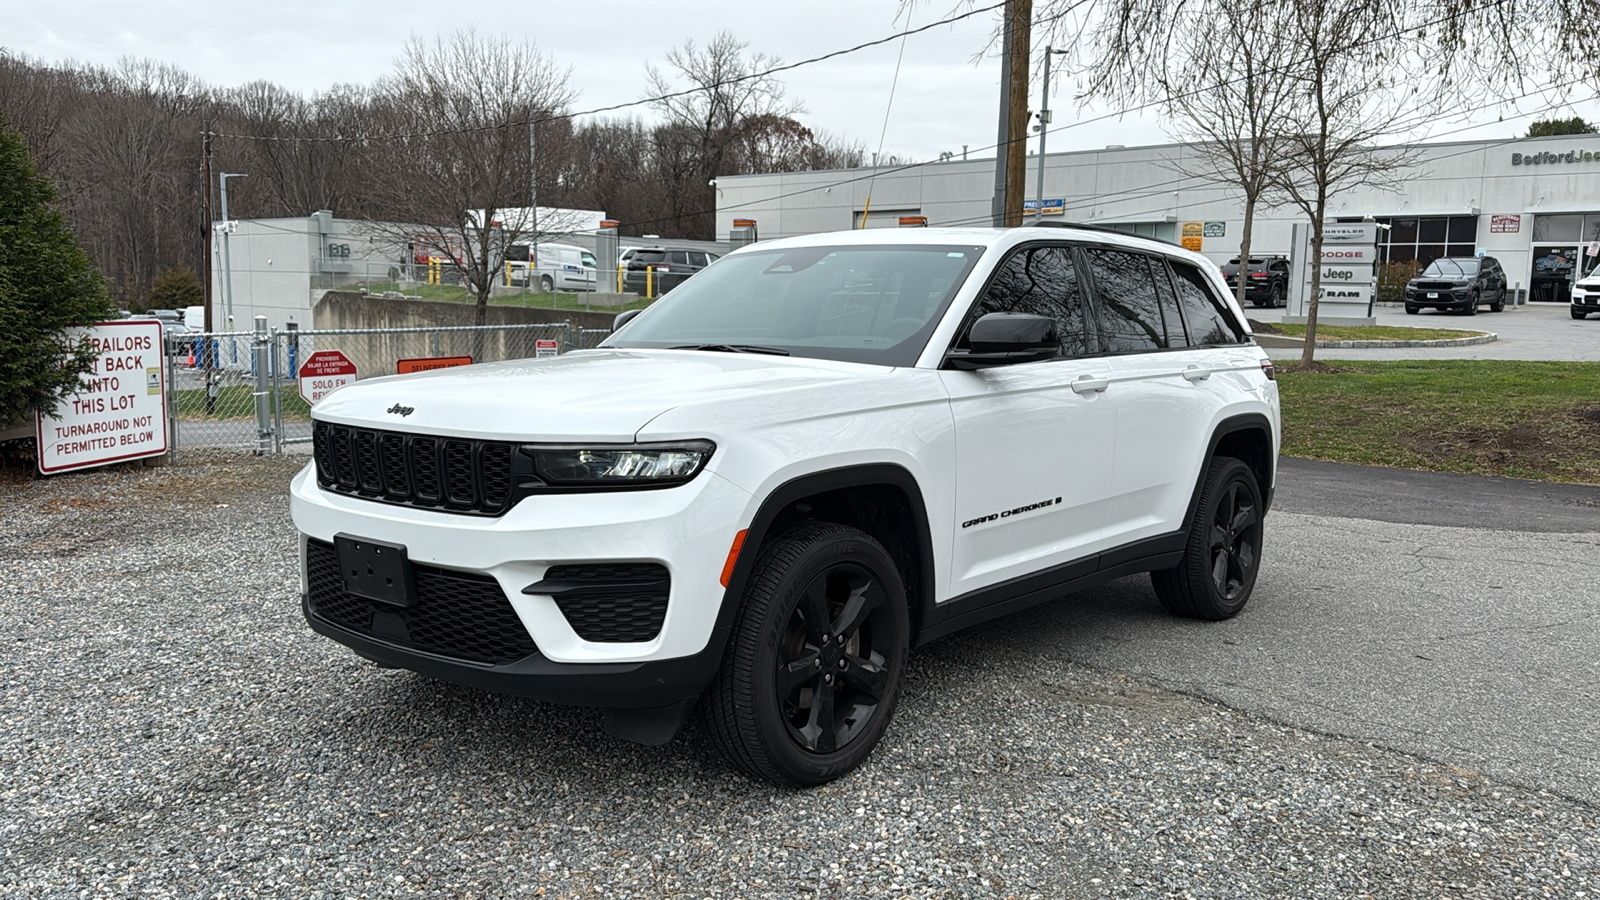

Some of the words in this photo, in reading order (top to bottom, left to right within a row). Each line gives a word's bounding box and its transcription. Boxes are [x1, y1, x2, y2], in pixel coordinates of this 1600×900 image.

[1322, 268, 1353, 280] Jeep
[85, 336, 151, 353] TRAILORS
[105, 355, 144, 372] BACK
[411, 363, 446, 373] DELIVERIES
[88, 377, 120, 393] INTO
[312, 380, 334, 390] SOLO
[335, 379, 346, 387] EN
[72, 398, 105, 415] THIS
[110, 395, 136, 411] LOT
[386, 402, 415, 418] Jeep
[55, 419, 130, 439] TURNAROUND
[133, 416, 152, 429] NOT
[56, 436, 117, 456] PERMITTED
[120, 431, 153, 446] BELOW
[962, 513, 999, 529] GRAND
[1000, 499, 1054, 518] CHEROKEE
